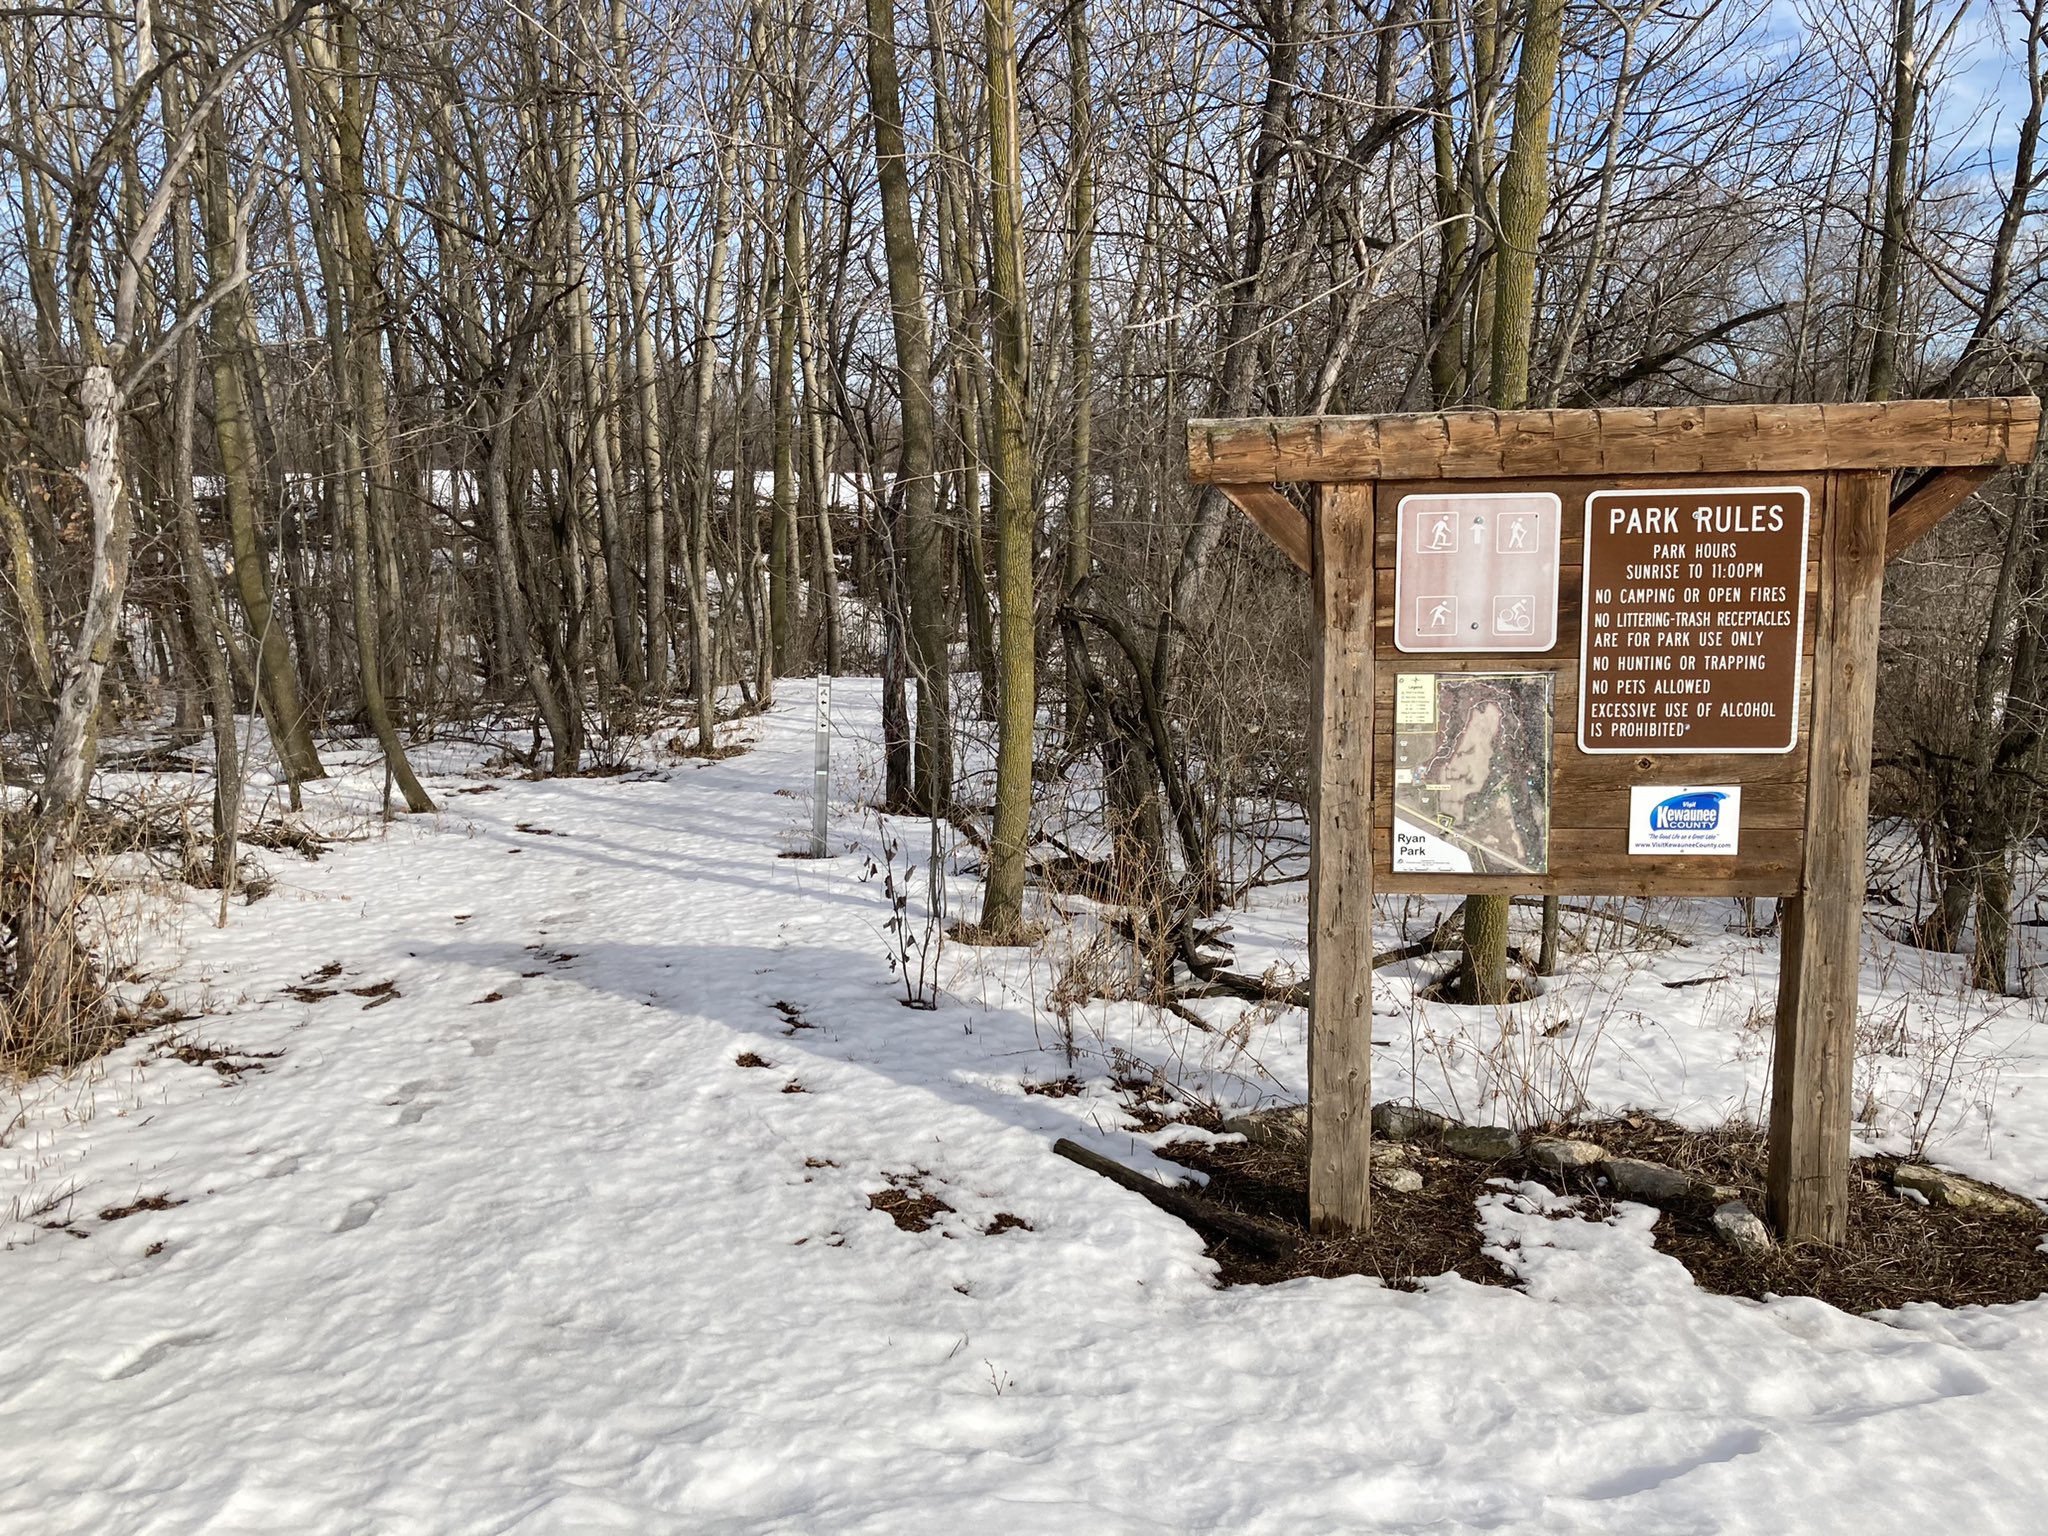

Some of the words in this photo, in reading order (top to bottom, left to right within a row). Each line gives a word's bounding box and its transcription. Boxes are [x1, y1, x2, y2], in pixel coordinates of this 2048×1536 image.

[1609, 507, 1679, 534] PARK
[1696, 504, 1784, 533] RULES
[1653, 544, 1686, 559] PARK
[1696, 543, 1737, 558] HOURS
[1626, 564, 1679, 579] SUNRISE
[1689, 564, 1702, 578] TO
[1712, 563, 1763, 578] 11:00PM
[1596, 589, 1611, 604] NO
[1620, 588, 1675, 604] CAMPING
[1684, 588, 1699, 603] OR
[1708, 588, 1740, 603] OPEN
[1750, 587, 1786, 602] FIRES
[1595, 613, 1609, 627] NO
[1617, 612, 1710, 627] LITTERING-TRASH
[1717, 611, 1790, 626] RECEPTACLES
[1594, 633, 1618, 647] ARE
[1628, 633, 1650, 647] FOR
[1657, 632, 1689, 647] PARK
[1699, 632, 1722, 646] USE
[1731, 631, 1763, 646] ONLY
[1593, 656, 1609, 671] NO
[1618, 656, 1671, 671] HUNTING
[1680, 656, 1695, 670] OR
[1705, 655, 1765, 670] TRAPPING
[1592, 680, 1608, 694] NO
[1617, 680, 1645, 694] PETS
[1654, 679, 1710, 694] ALLOWED
[1591, 703, 1656, 717] EXCESSIVE
[1665, 703, 1688, 717] USE
[1697, 703, 1712, 717] OF
[1721, 702, 1776, 717] ALCOHOL
[1591, 723, 1602, 736] IS
[1611, 723, 1684, 736] PROHIBITED
[1657, 806, 1716, 828] Kewaunee
[1398, 834, 1425, 844] Ryan
[1401, 847, 1425, 855] Park
